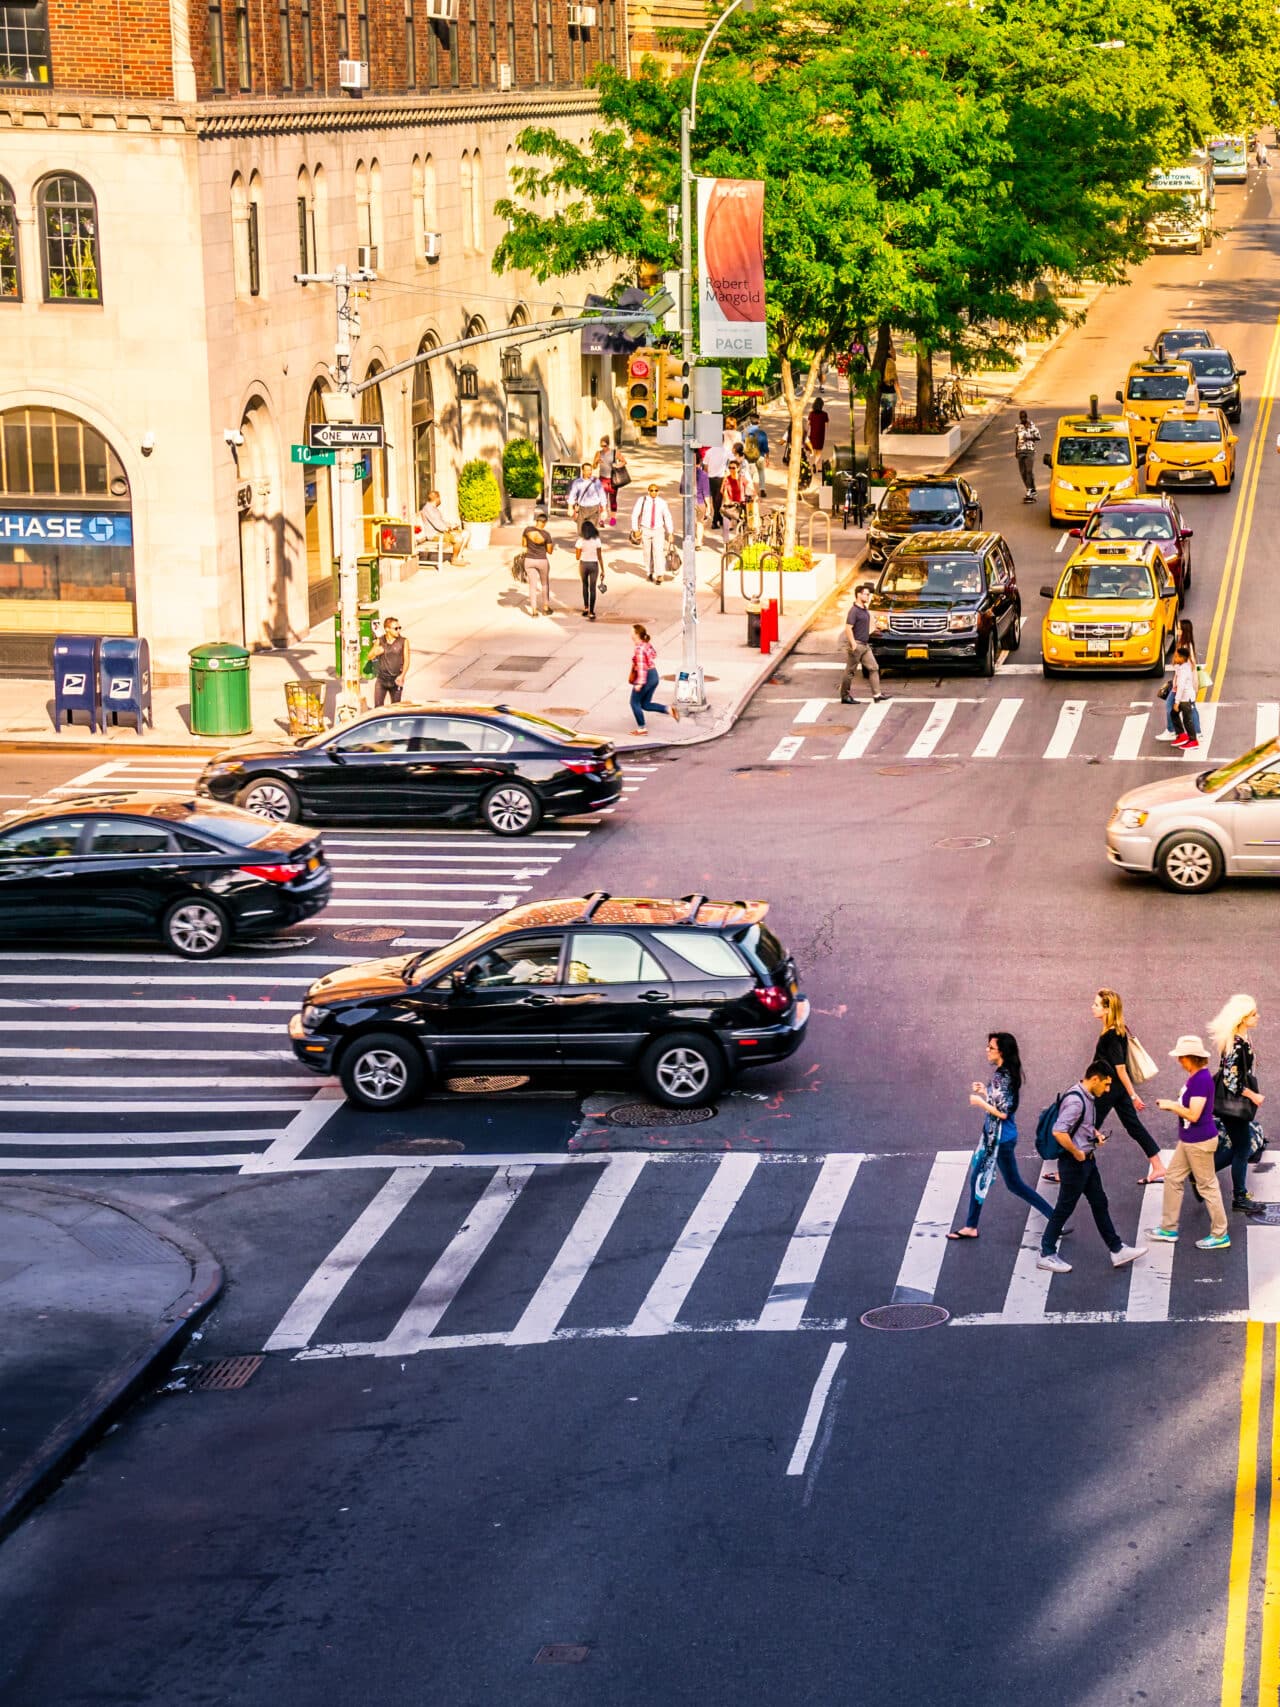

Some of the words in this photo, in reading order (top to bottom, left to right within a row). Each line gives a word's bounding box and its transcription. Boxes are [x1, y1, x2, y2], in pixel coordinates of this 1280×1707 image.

[716, 184, 748, 198] NYC
[705, 277, 749, 290] Robert
[706, 290, 760, 306] Mangold
[716, 338, 753, 350] PACE
[321, 431, 342, 441] ONE
[352, 432, 373, 441] WAY
[297, 447, 312, 461] 10
[0, 517, 84, 539] HASE
